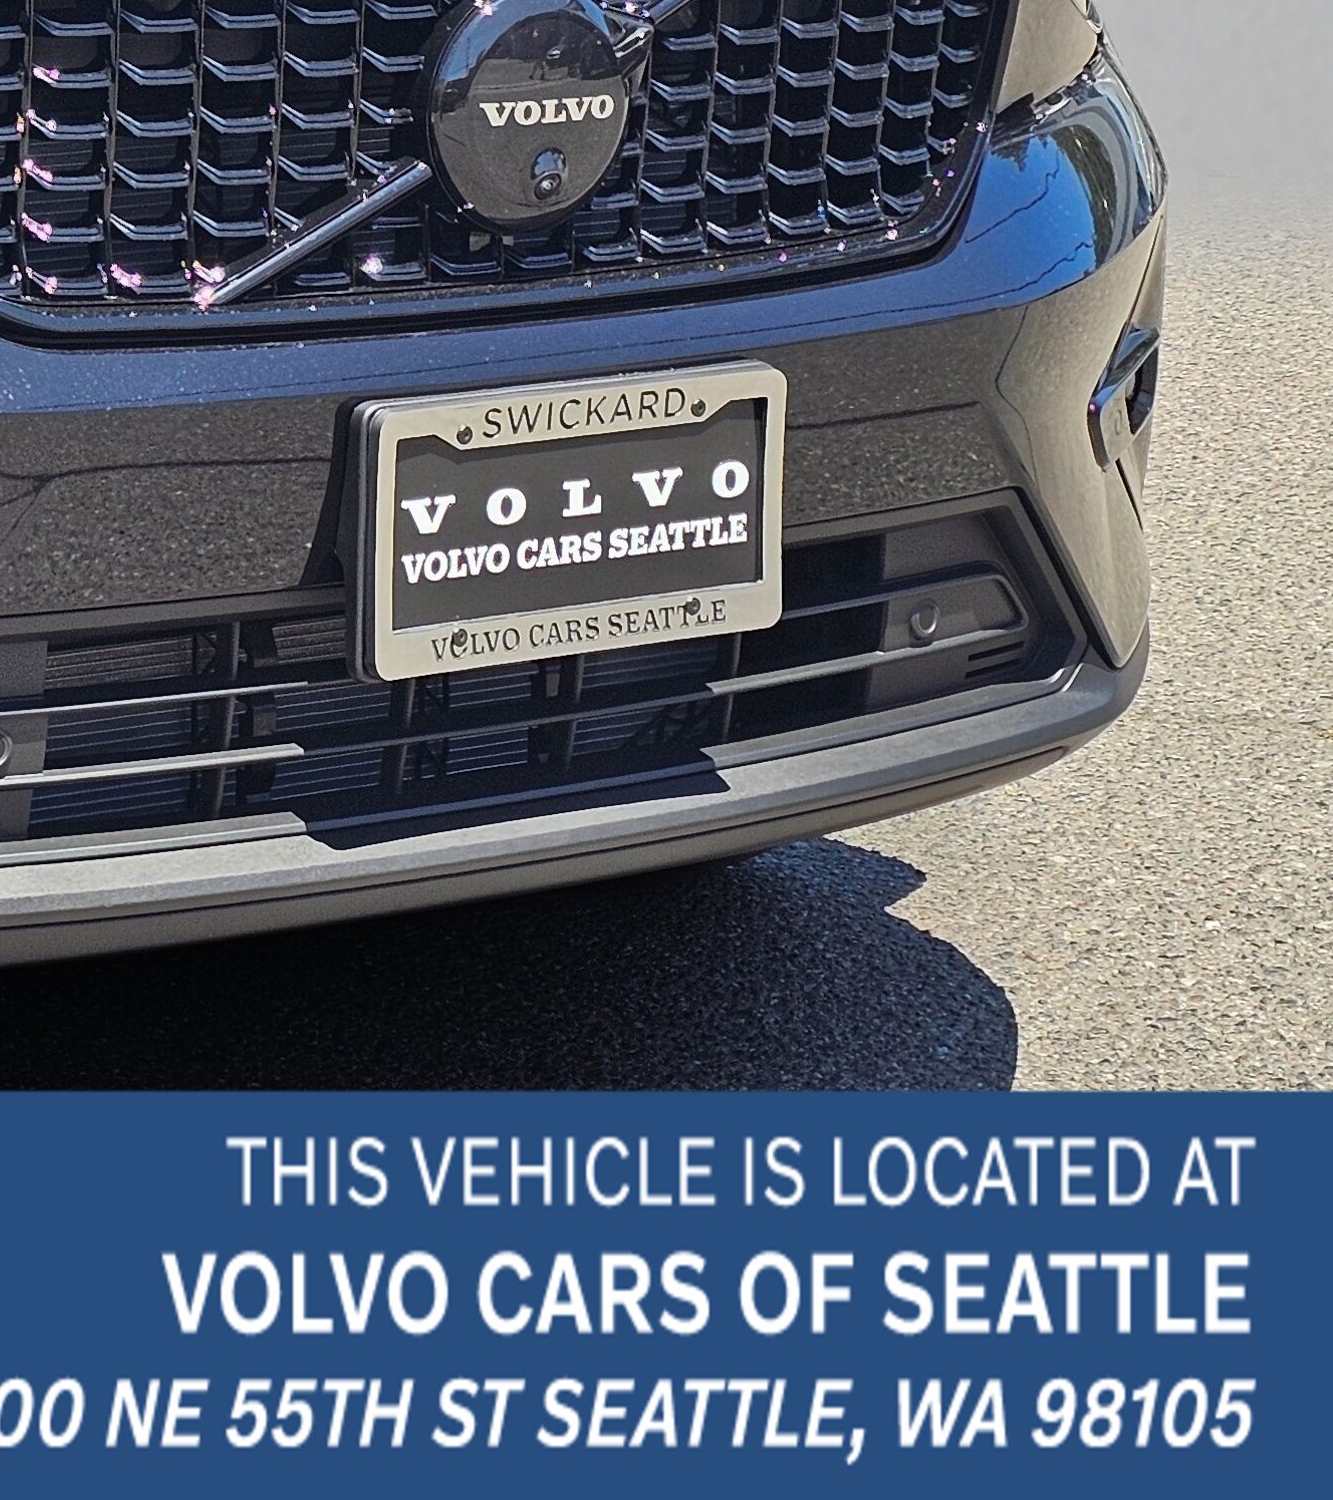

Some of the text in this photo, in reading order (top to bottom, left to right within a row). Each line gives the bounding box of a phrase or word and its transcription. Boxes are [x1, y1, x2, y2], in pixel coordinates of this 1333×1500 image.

[479, 94, 614, 127] VOLVO
[482, 387, 686, 438] SWICKARD
[400, 459, 750, 535] VOLVO
[401, 512, 748, 584] VOLVO CARS SEATTLE
[529, 616, 601, 650] CARS
